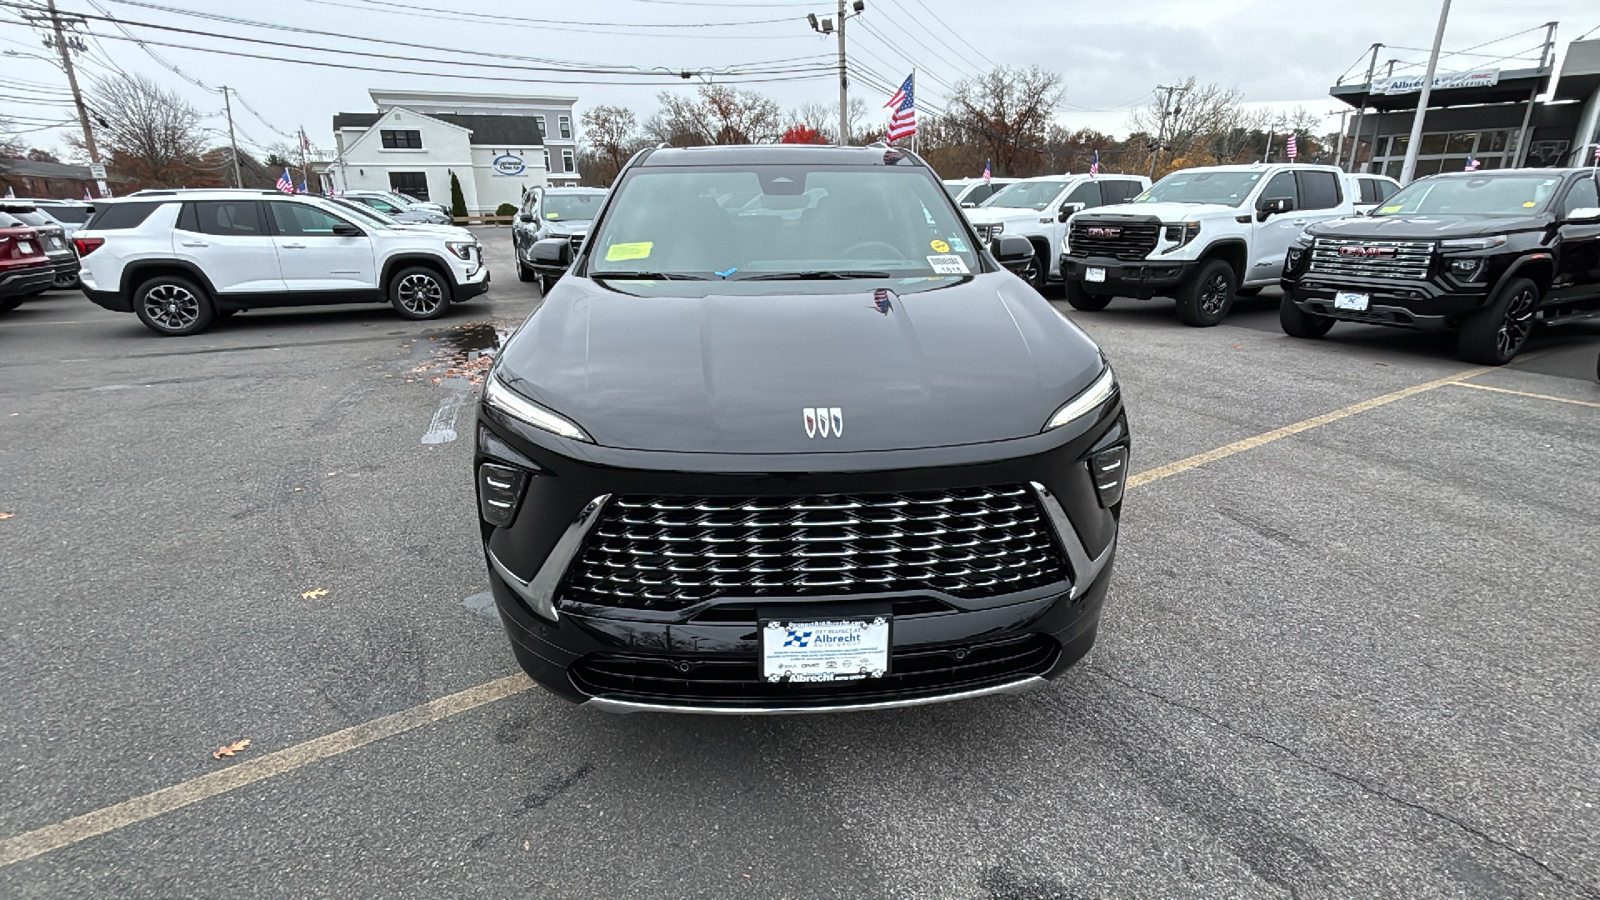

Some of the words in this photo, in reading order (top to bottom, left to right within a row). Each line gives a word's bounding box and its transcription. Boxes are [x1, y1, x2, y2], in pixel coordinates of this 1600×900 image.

[1391, 78, 1440, 89] Albret
[1086, 227, 1121, 238] GMC
[1338, 245, 1397, 258] GMC
[814, 633, 861, 643] Albrecht
[788, 673, 835, 682] Albrecht
